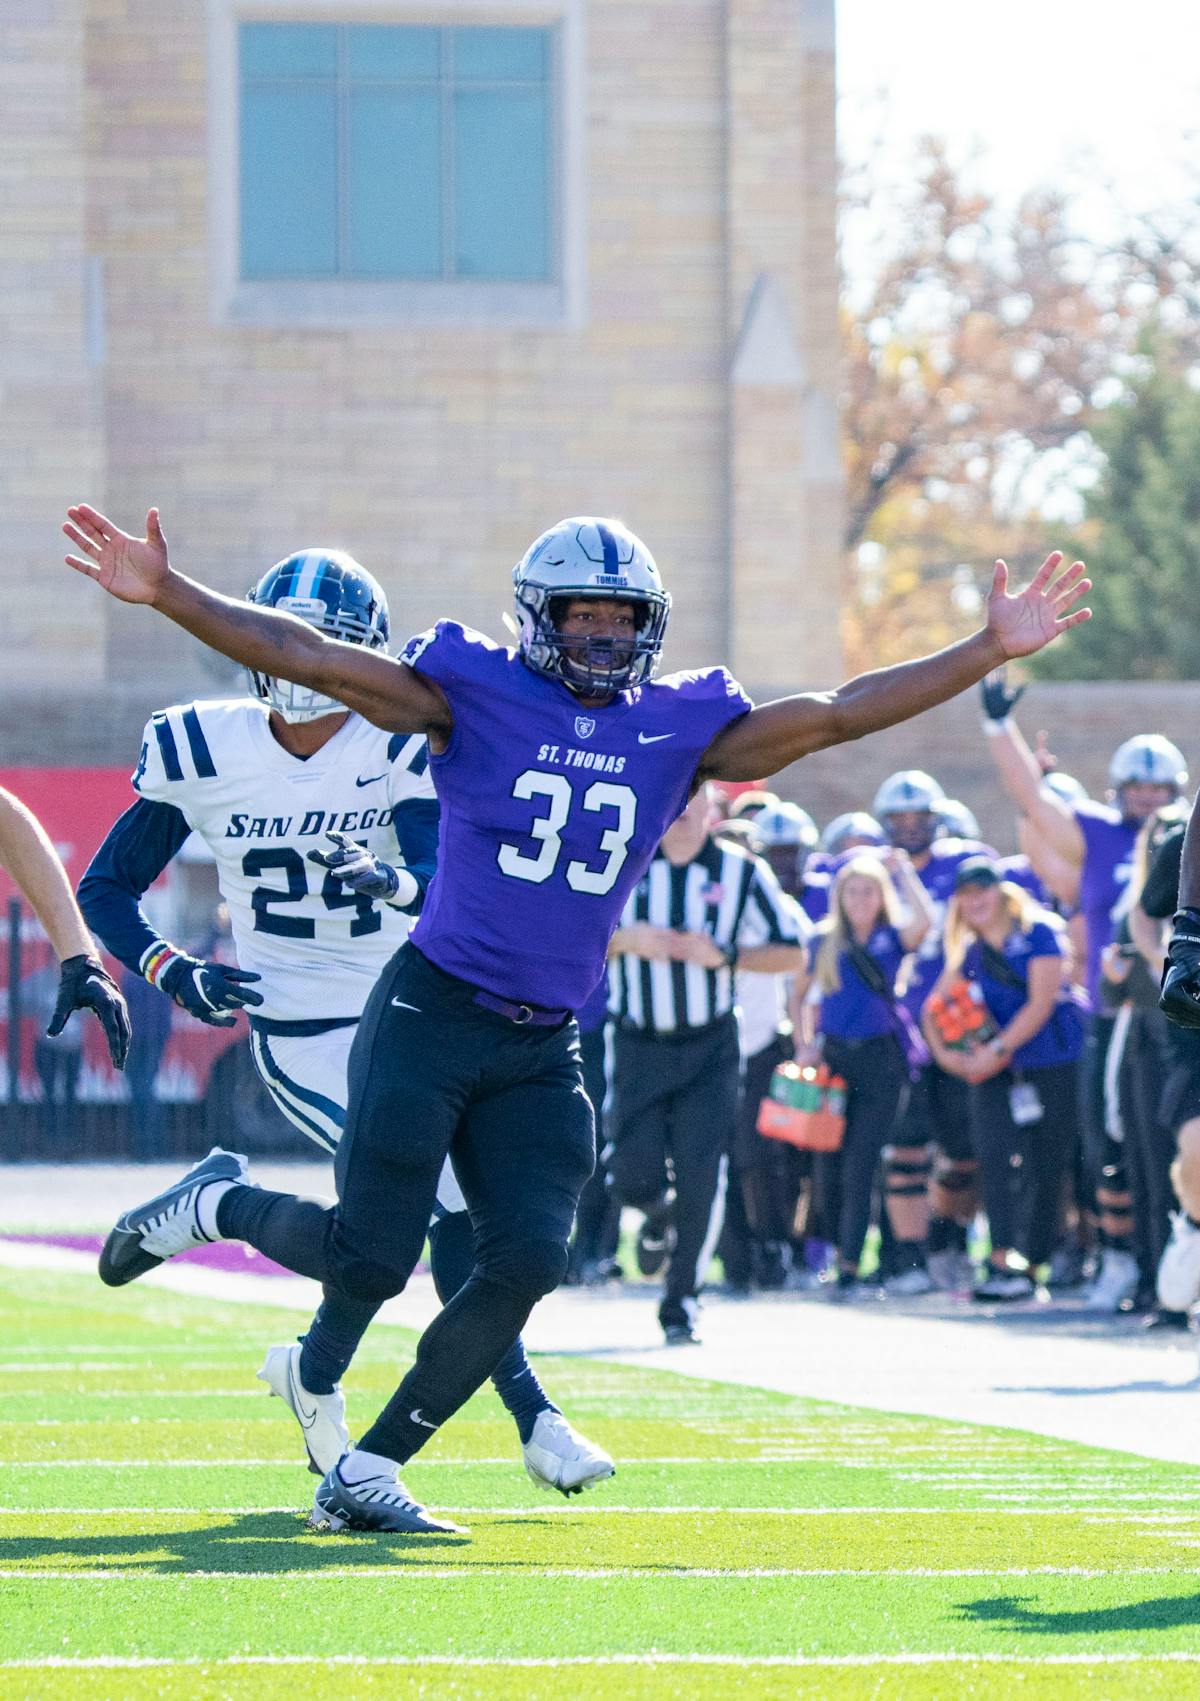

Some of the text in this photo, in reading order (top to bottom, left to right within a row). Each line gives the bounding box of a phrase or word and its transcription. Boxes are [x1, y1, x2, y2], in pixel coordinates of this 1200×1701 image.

[595, 575, 628, 586] TOMMIES
[537, 744, 627, 773] ST. THOMAS
[225, 807, 394, 838] SAN DIEGO
[497, 769, 638, 896] 33
